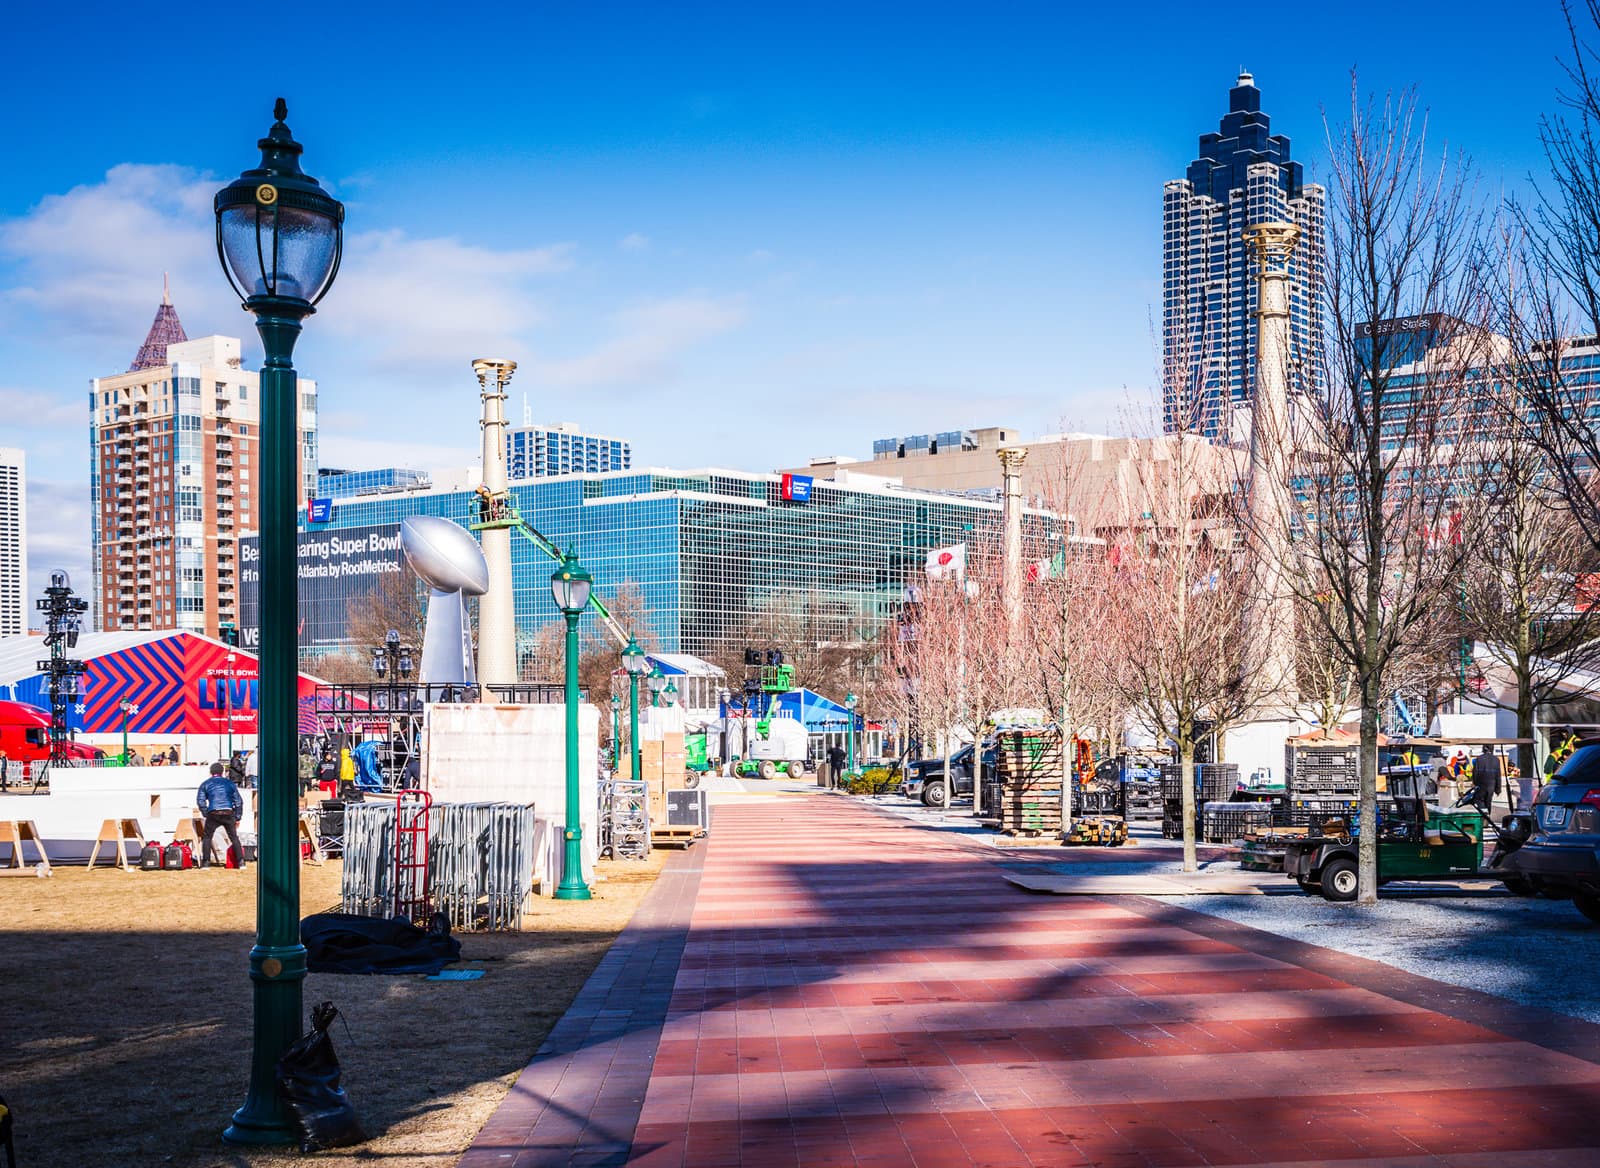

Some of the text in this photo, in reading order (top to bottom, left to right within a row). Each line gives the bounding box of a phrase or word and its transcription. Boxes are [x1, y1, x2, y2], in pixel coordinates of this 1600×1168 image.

[331, 536, 368, 558] Super
[369, 531, 401, 552] Bowl
[297, 564, 328, 578] Atlanta
[328, 562, 341, 579] by
[341, 558, 401, 575] RootMetrics.
[207, 668, 259, 677] SUPER BOWL
